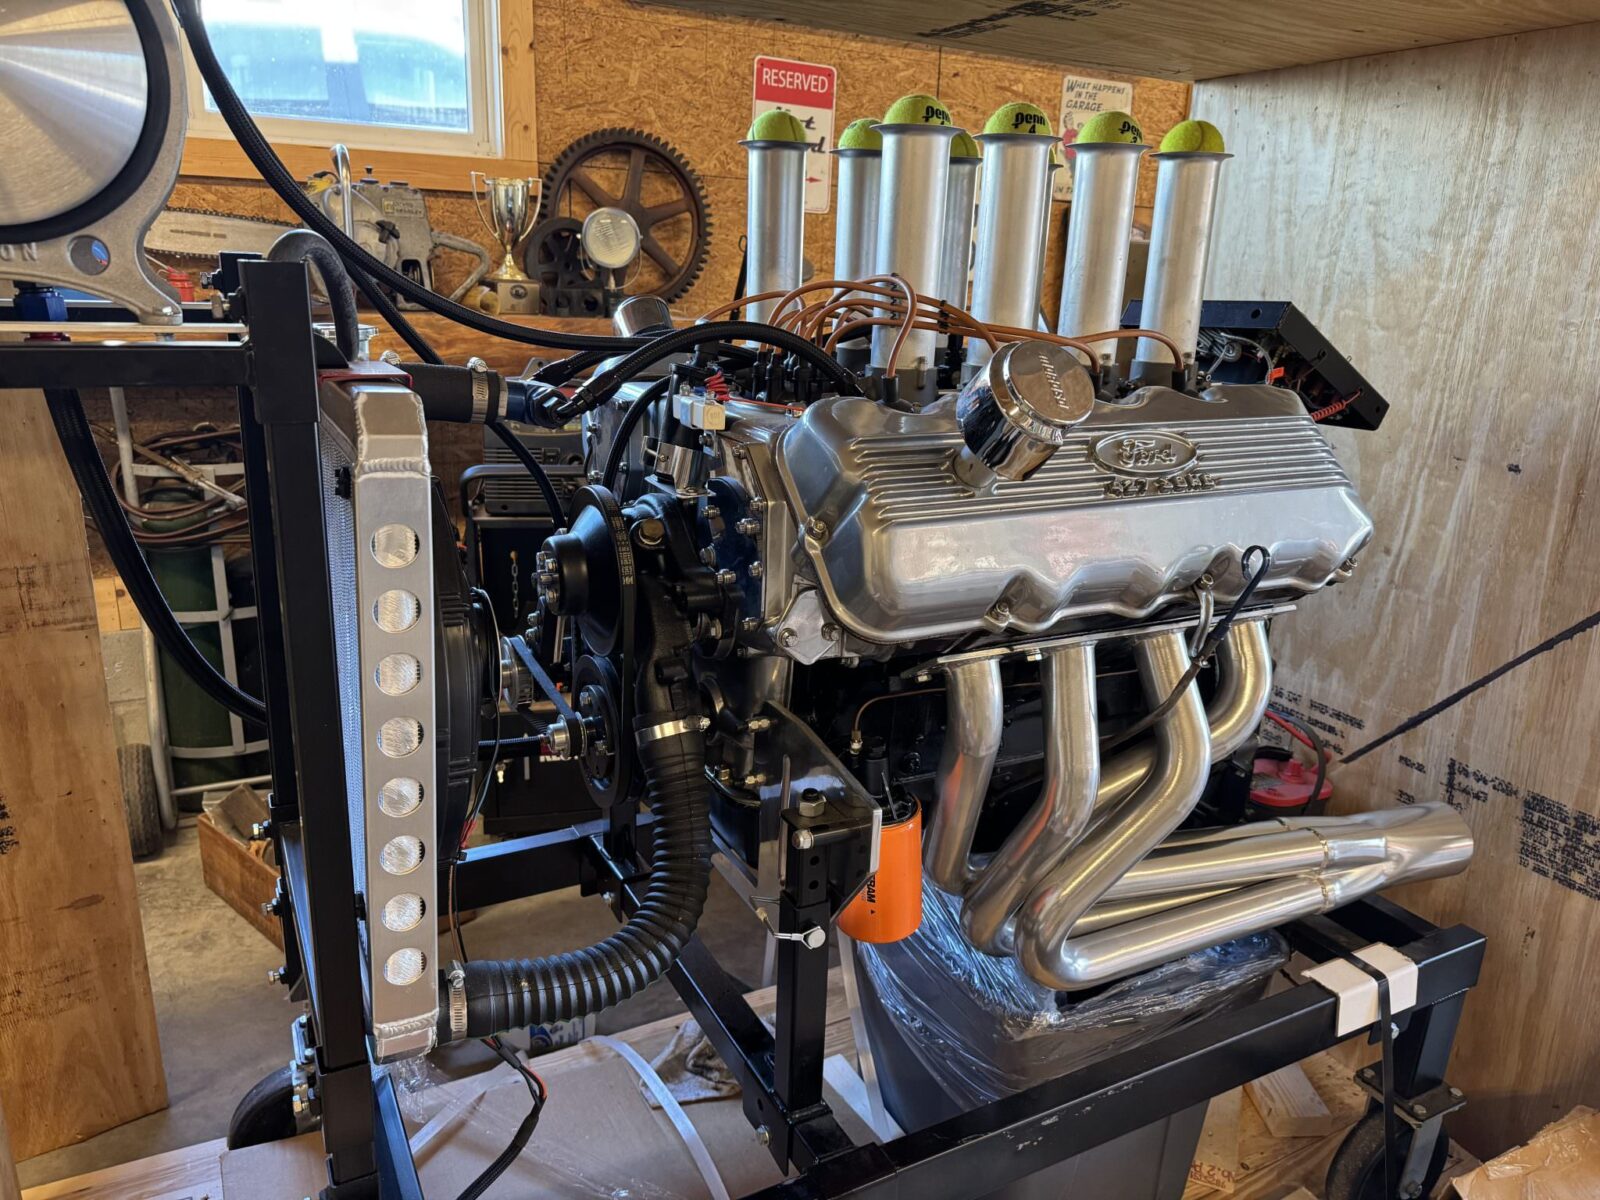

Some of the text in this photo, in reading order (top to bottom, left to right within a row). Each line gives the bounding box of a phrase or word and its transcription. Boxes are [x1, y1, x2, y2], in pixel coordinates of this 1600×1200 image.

[762, 67, 829, 94] RESERVED
[1011, 112, 1046, 128] penn
[1119, 439, 1178, 468] Ford
